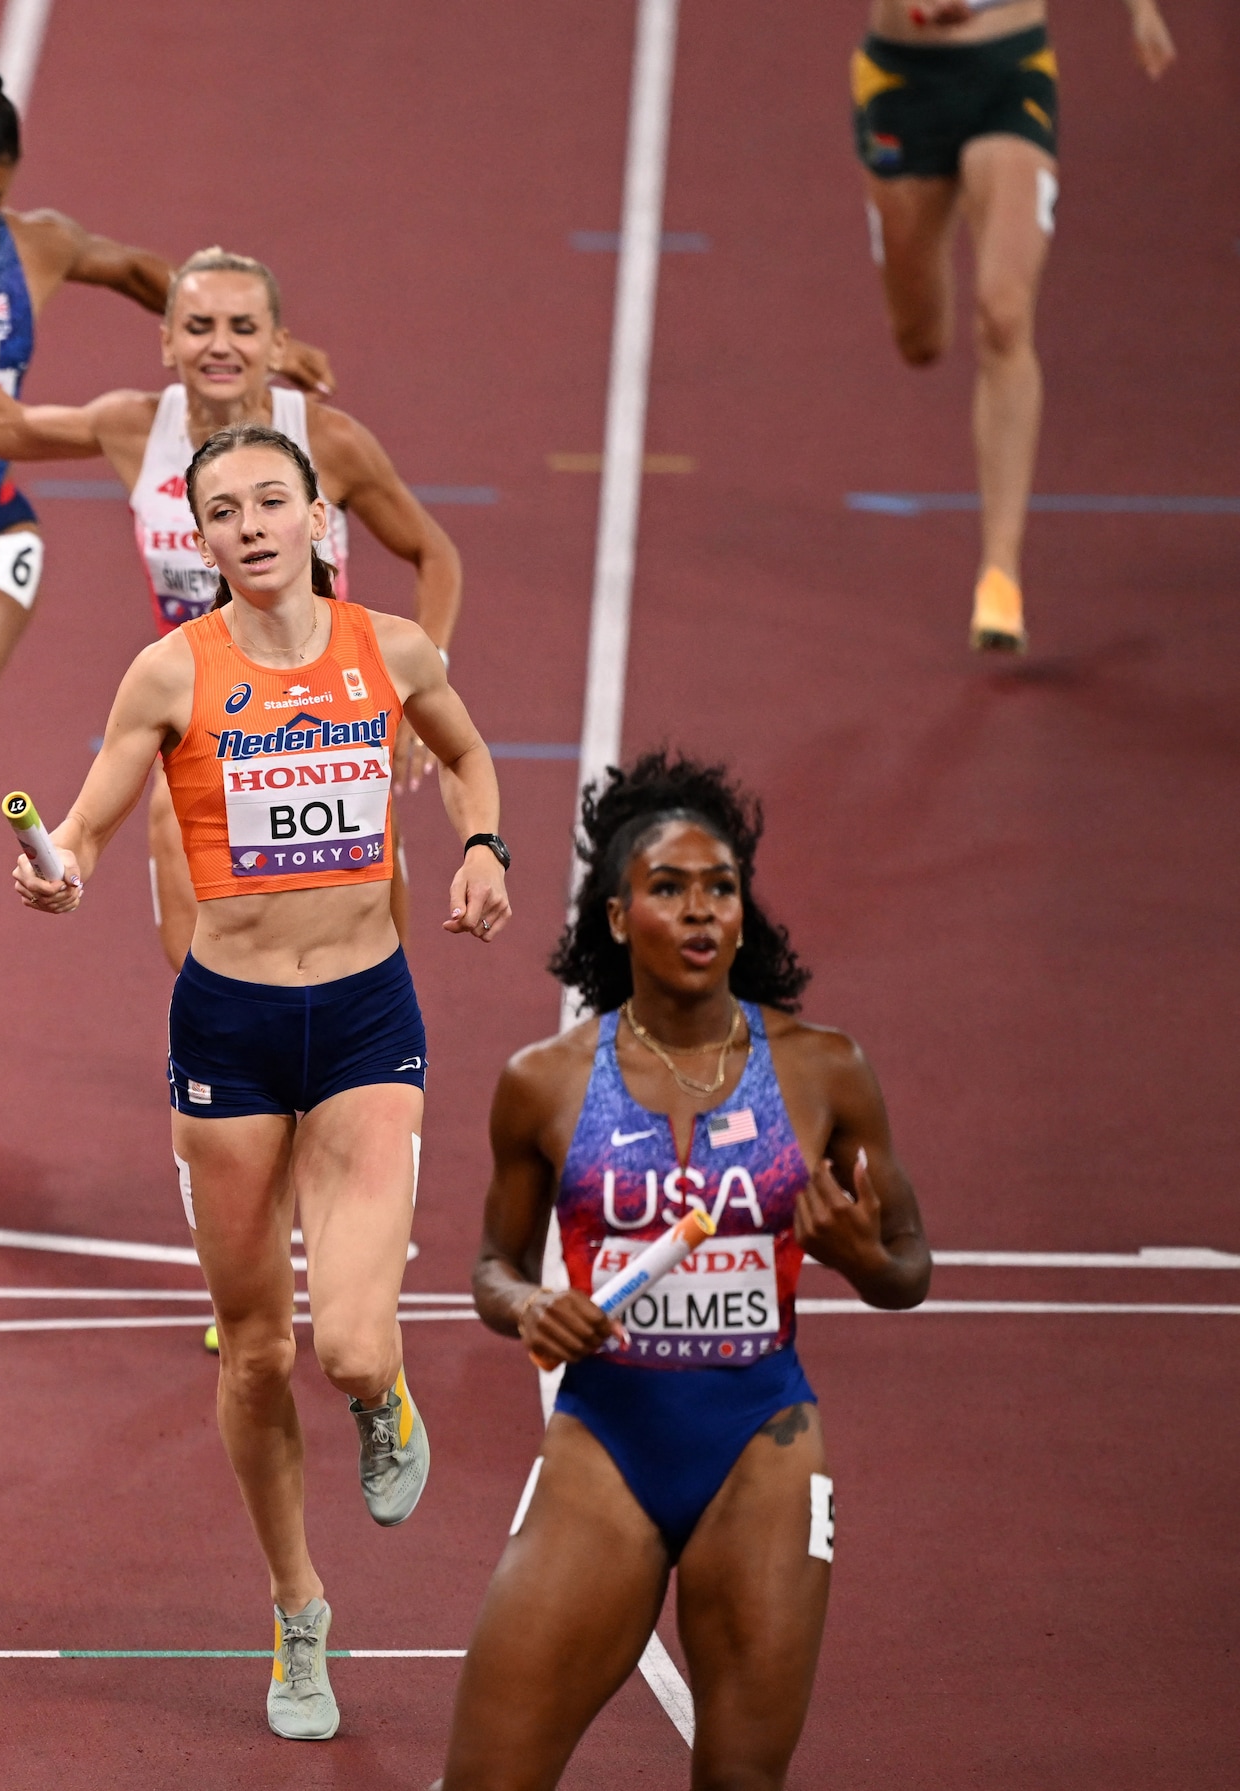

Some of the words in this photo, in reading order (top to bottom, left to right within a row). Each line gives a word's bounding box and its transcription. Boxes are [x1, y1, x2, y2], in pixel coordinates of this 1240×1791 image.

[12, 547, 32, 588] 6
[263, 692, 334, 711] Staatsloterij
[228, 759, 389, 793] HONDA
[10, 799, 25, 812] 27
[269, 799, 361, 840] BOL
[603, 1165, 764, 1230] USA
[598, 1249, 770, 1275] HNDA
